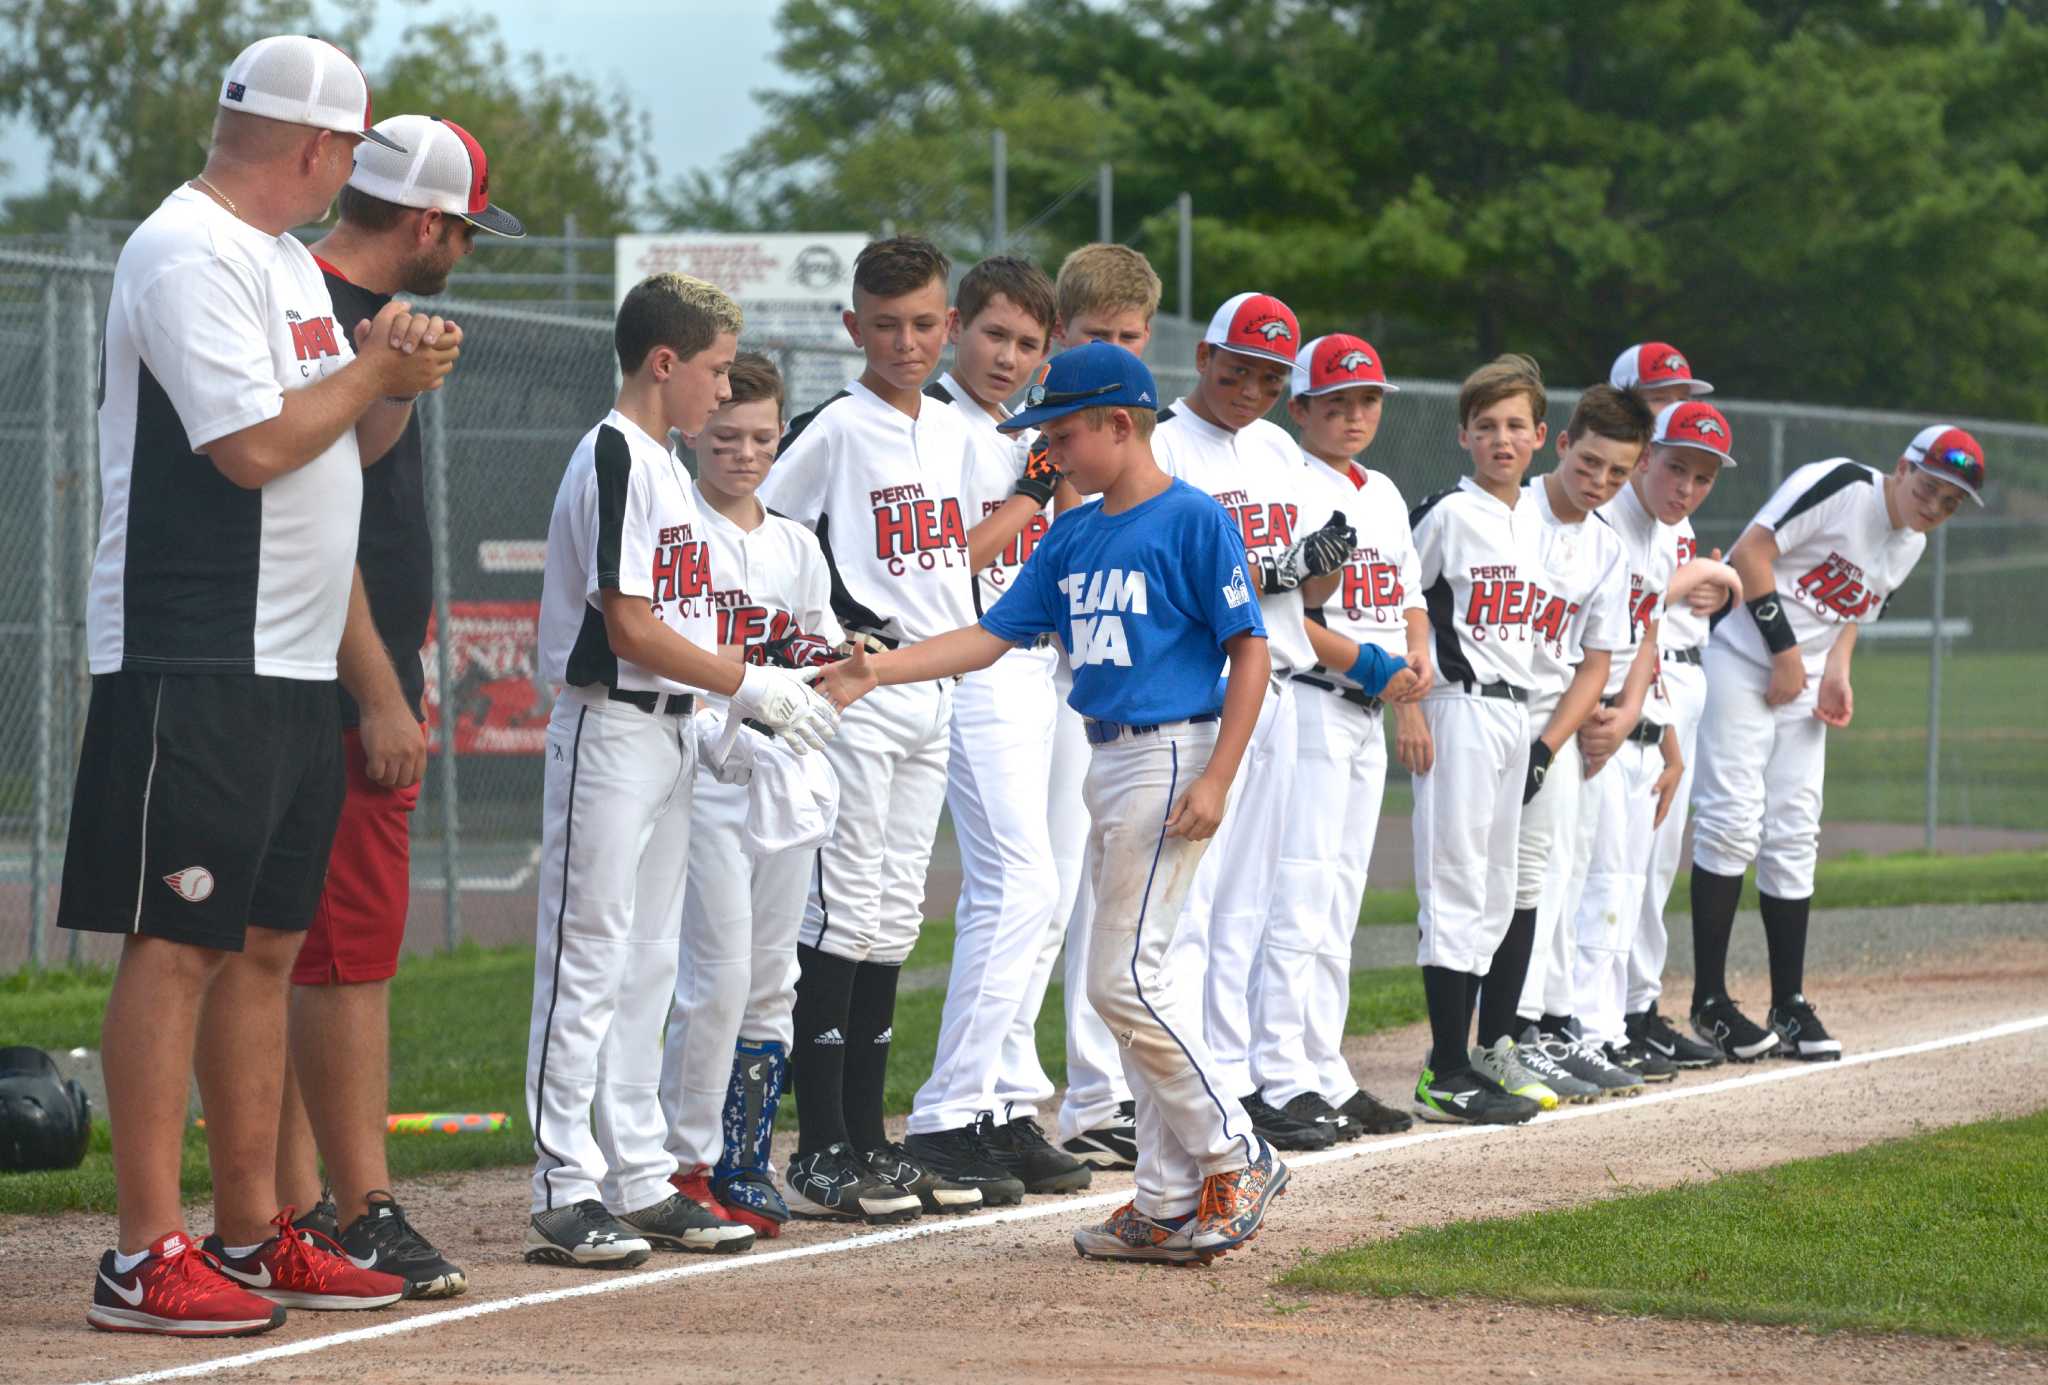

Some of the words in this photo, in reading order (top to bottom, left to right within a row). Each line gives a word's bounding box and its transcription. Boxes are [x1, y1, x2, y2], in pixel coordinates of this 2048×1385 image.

[870, 483, 925, 507] PERTH
[1212, 489, 1249, 507] ERTH
[659, 523, 693, 545] ERTH
[873, 497, 968, 561] HEA
[1227, 503, 1298, 550] EAT
[887, 548, 968, 577] COLT
[1350, 547, 1380, 562] ERTH
[1828, 551, 1864, 579] PERTH
[652, 541, 714, 604] HEA
[1343, 562, 1406, 610] HEA
[1470, 565, 1517, 580] PERTH
[713, 589, 752, 609] RTH
[1466, 580, 1536, 626] HEA
[1798, 562, 1882, 619] HEA
[651, 596, 714, 622] COLT
